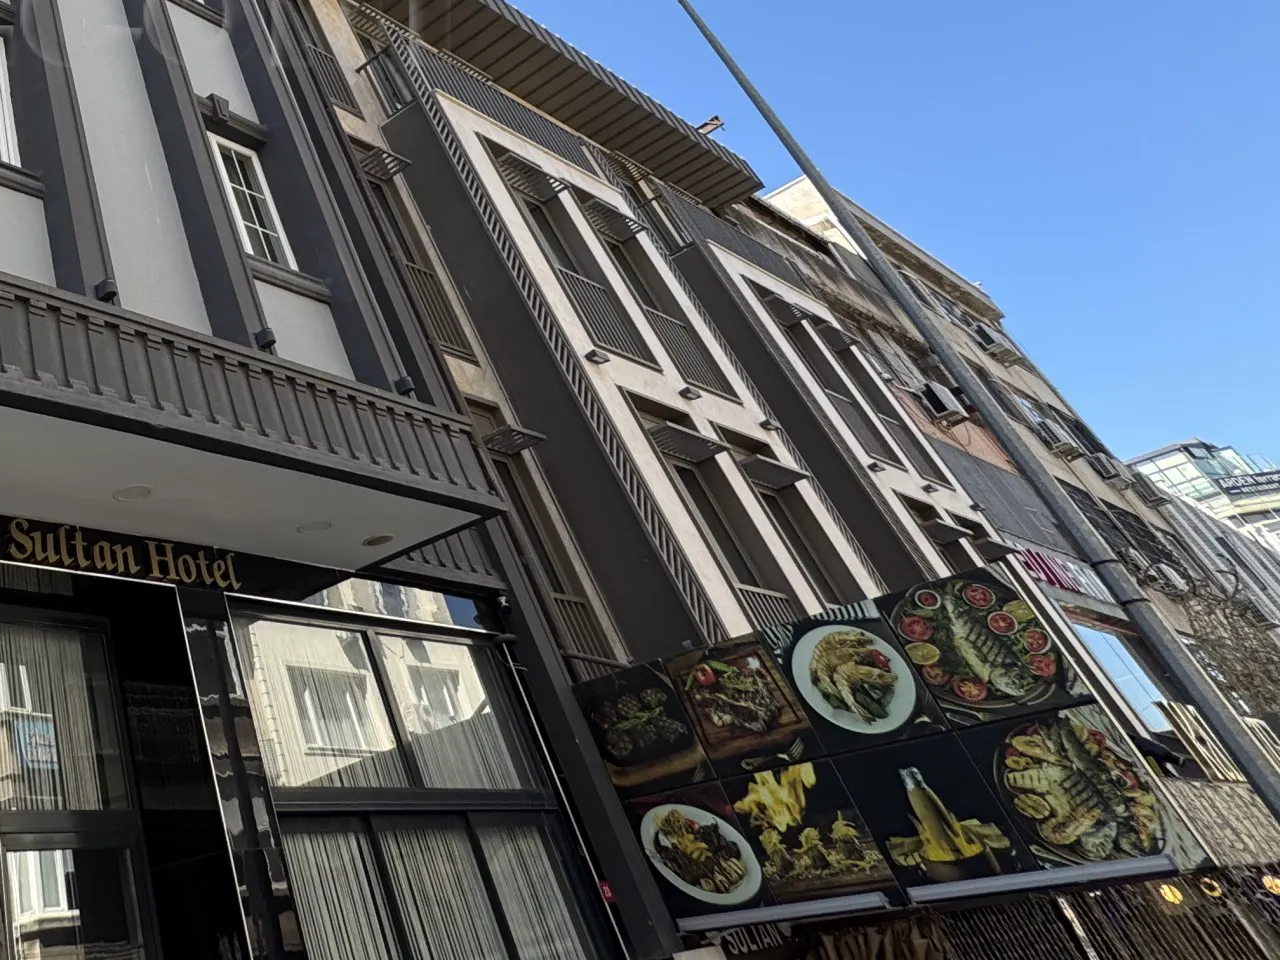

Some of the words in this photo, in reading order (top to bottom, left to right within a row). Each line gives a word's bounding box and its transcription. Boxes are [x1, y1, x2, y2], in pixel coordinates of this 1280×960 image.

[6, 518, 142, 574] Sultan
[145, 541, 242, 590] Hotel
[724, 923, 783, 955] SULTAN
